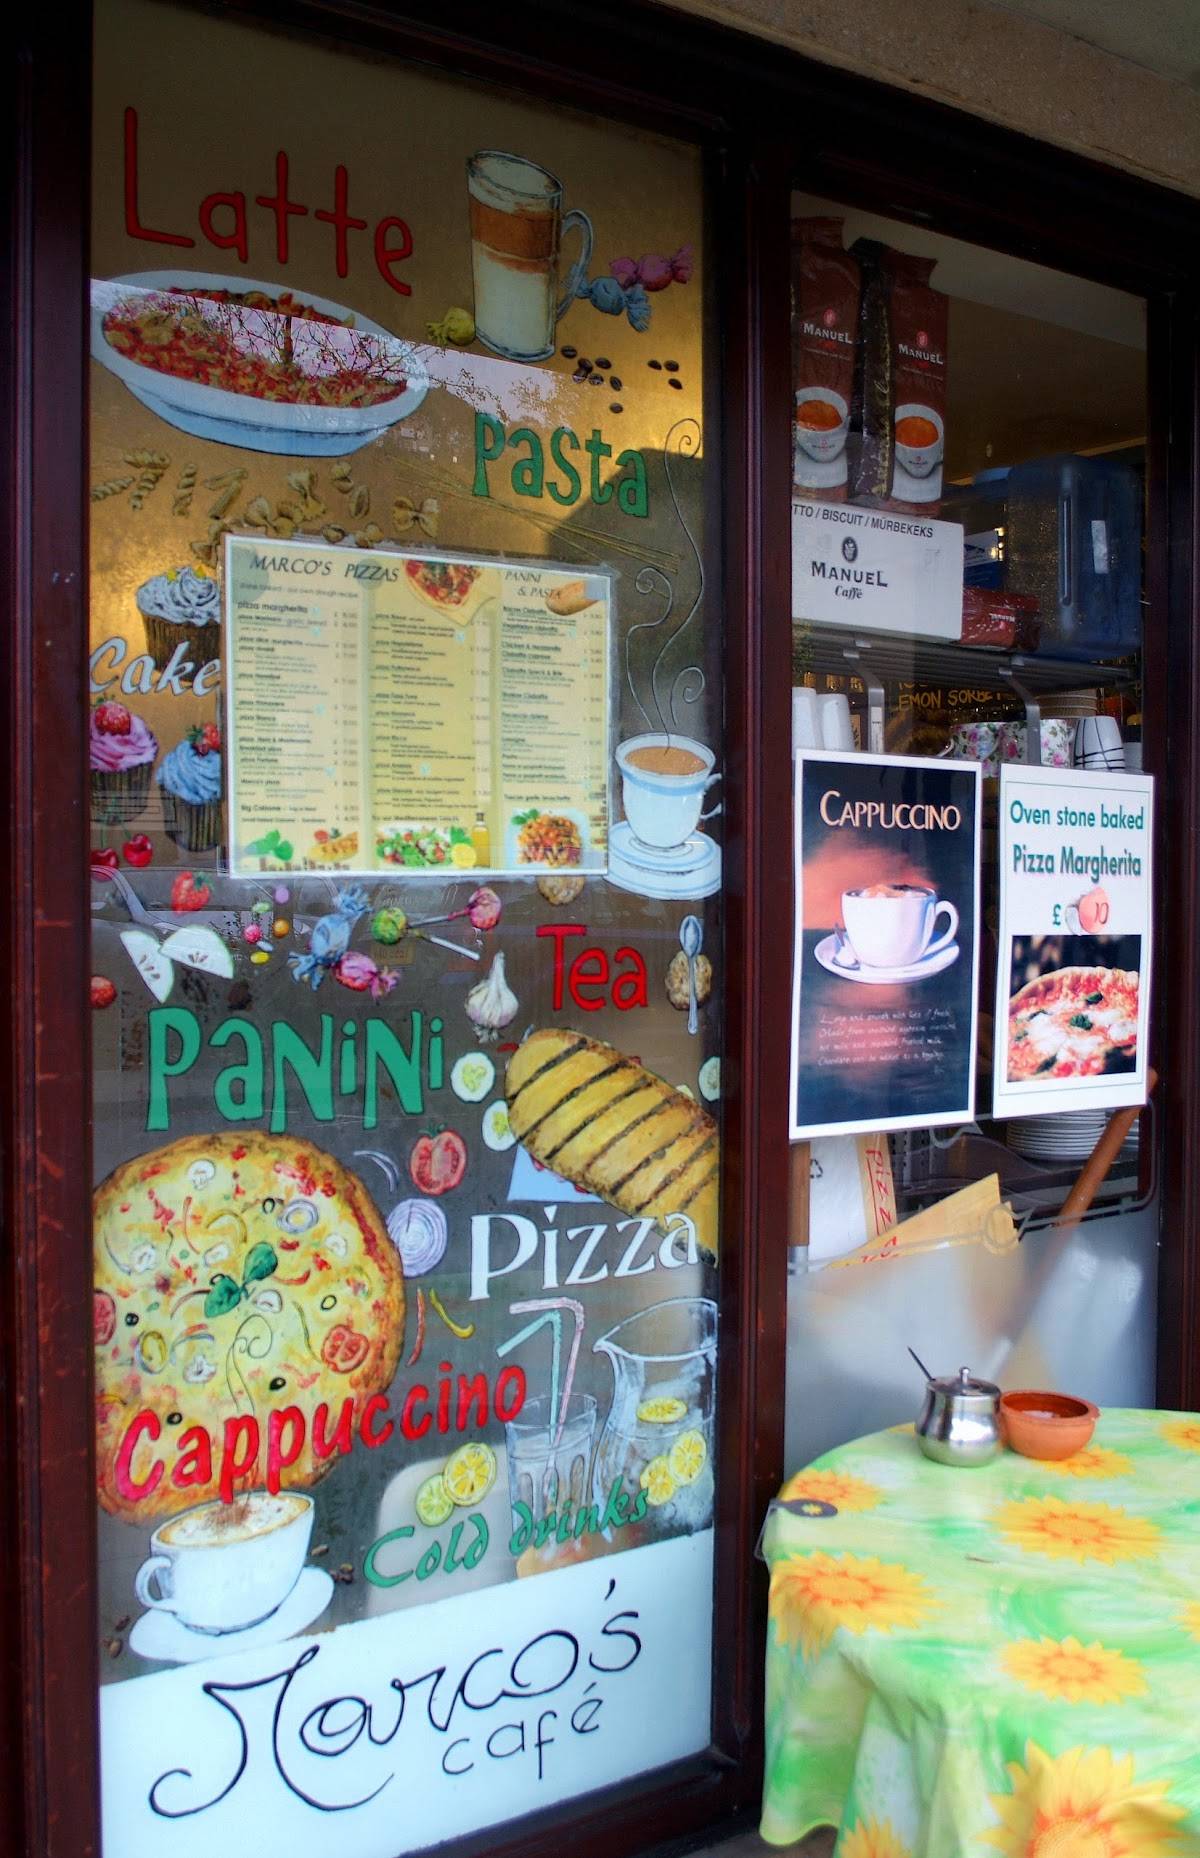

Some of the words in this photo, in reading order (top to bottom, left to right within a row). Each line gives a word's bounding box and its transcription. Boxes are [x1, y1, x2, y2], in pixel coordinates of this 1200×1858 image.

[123, 105, 414, 297] Latte
[803, 322, 853, 344] MANUEL
[898, 343, 944, 366] MANUEL
[822, 509, 864, 526] BISCUIT
[249, 554, 333, 577] MARCO'S
[344, 563, 400, 583] PIZZAS
[504, 571, 542, 583] PANINI
[811, 560, 888, 588] MANUEL
[89, 635, 221, 697] Cake
[819, 790, 961, 831] CAPPUCCINO
[1010, 799, 1050, 824] Oven
[1056, 806, 1095, 828] stone
[1100, 803, 1143, 830] baked
[1012, 843, 1054, 874] Pizza
[1060, 845, 1141, 884] Margherita
[536, 923, 648, 1012] Tea
[469, 1203, 700, 1301] Pizza
[113, 1362, 528, 1505] Cappuccino
[362, 1510, 490, 1589] Cold
[508, 1474, 649, 1558] drinks
[148, 1578, 643, 1820] Marco's
[441, 1681, 607, 1780] café
